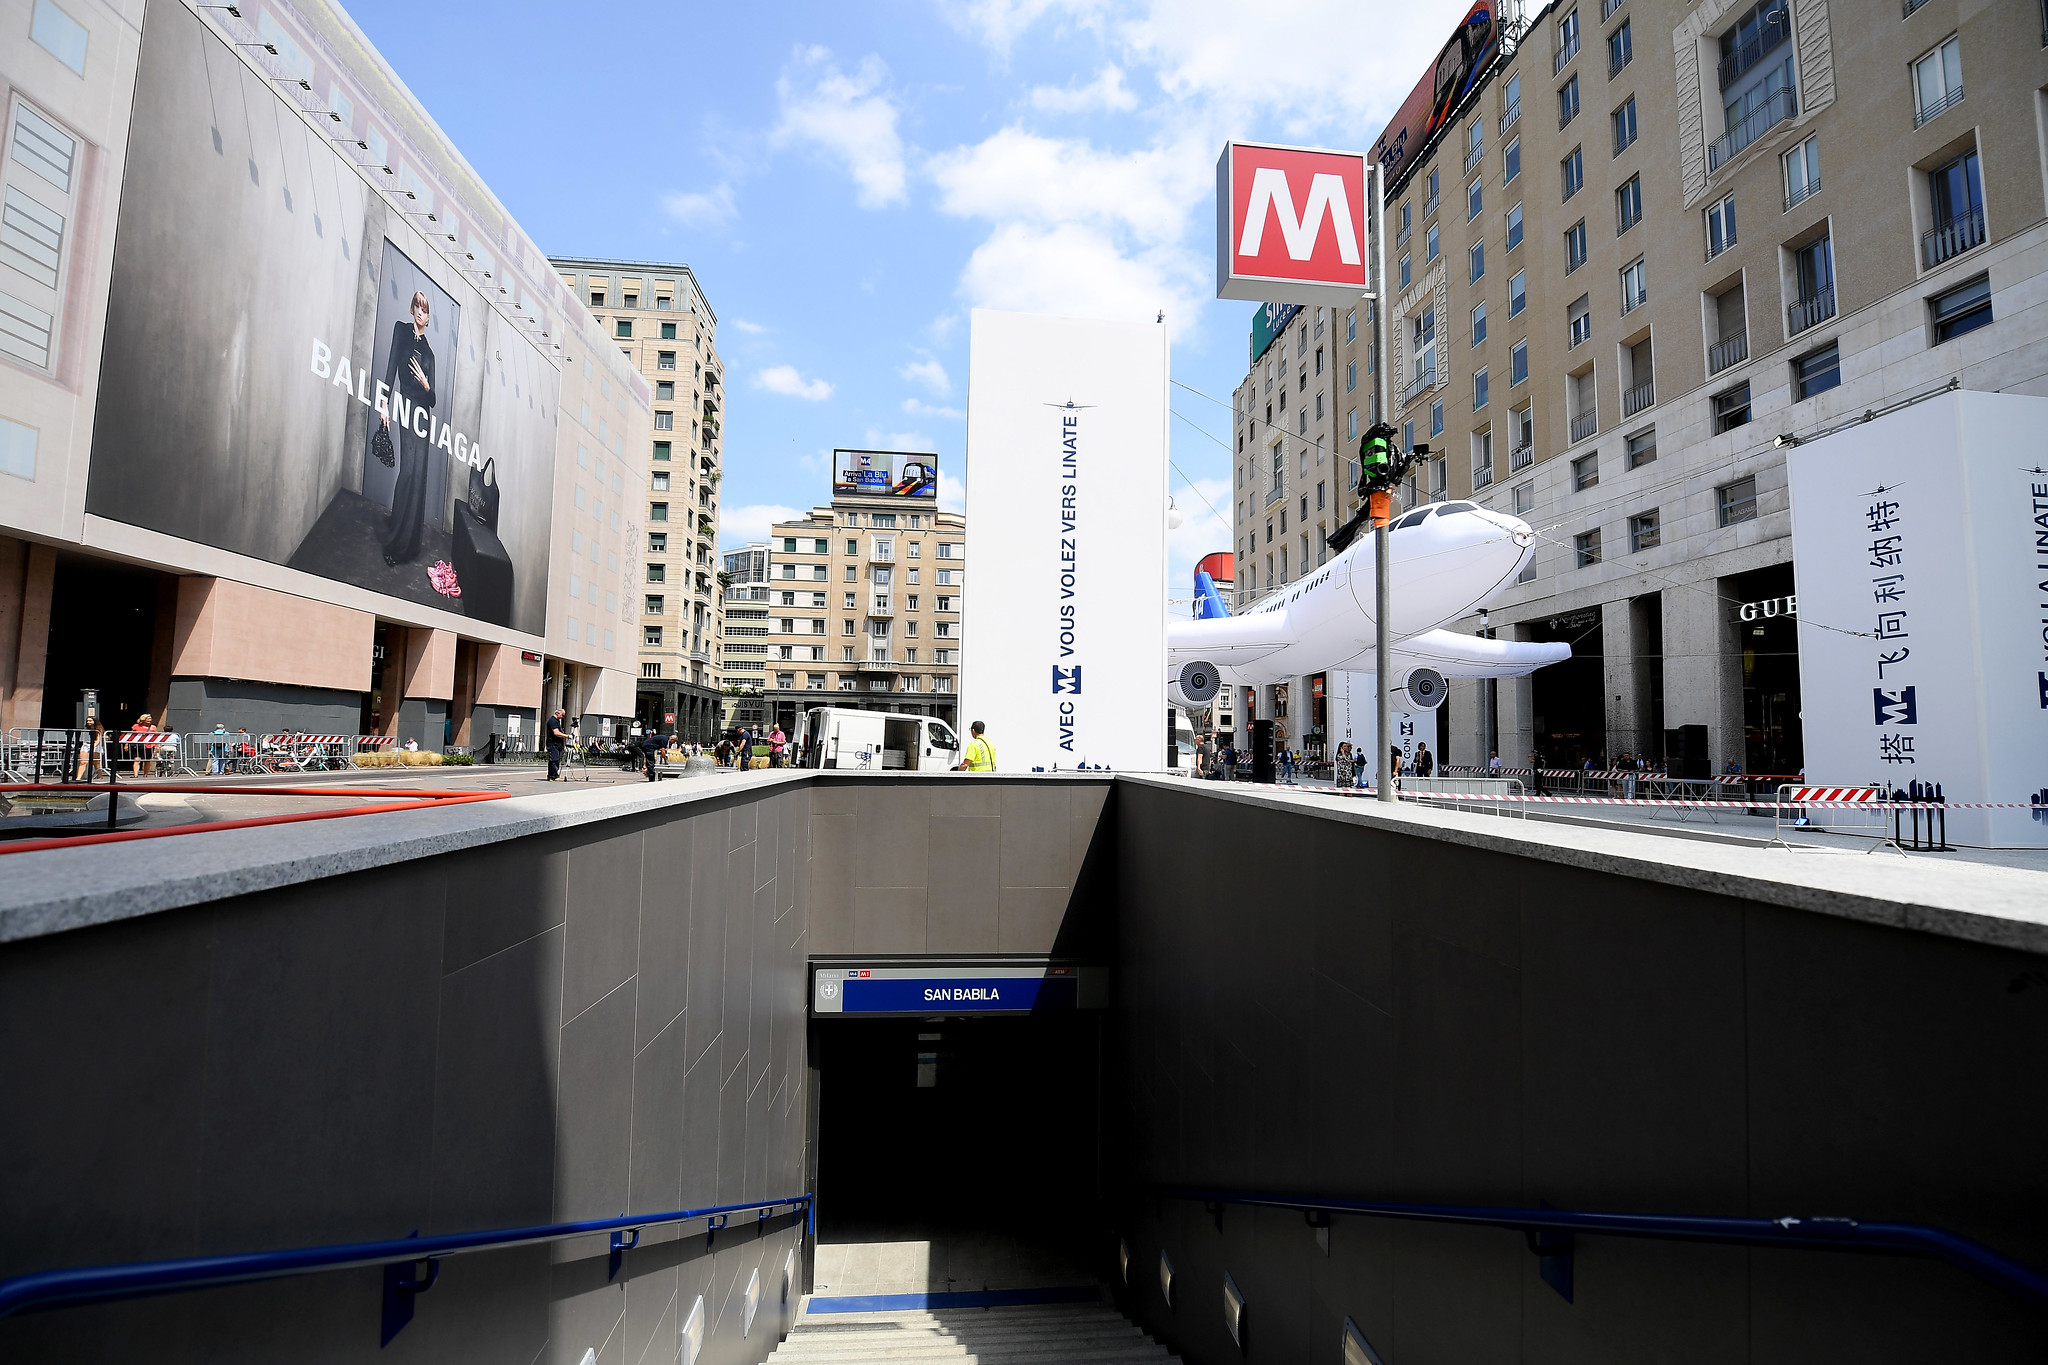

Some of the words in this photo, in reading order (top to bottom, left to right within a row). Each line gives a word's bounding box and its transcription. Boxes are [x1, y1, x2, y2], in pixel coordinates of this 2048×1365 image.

[1238, 167, 1361, 265] M
[311, 337, 481, 472] BALENCIAGA
[1063, 416, 1077, 478] LINATE
[1062, 485, 1076, 533] VERS
[1061, 539, 1075, 599] VOLEZ
[1866, 500, 1909, 680] 飞向利纳特
[1060, 605, 1074, 657] VOUS
[1059, 702, 1074, 752] AVEC
[1403, 738, 1411, 759] CON
[1880, 733, 1915, 764] 搭
[924, 988, 951, 1001] SAN
[953, 988, 1000, 1000] BABILA
